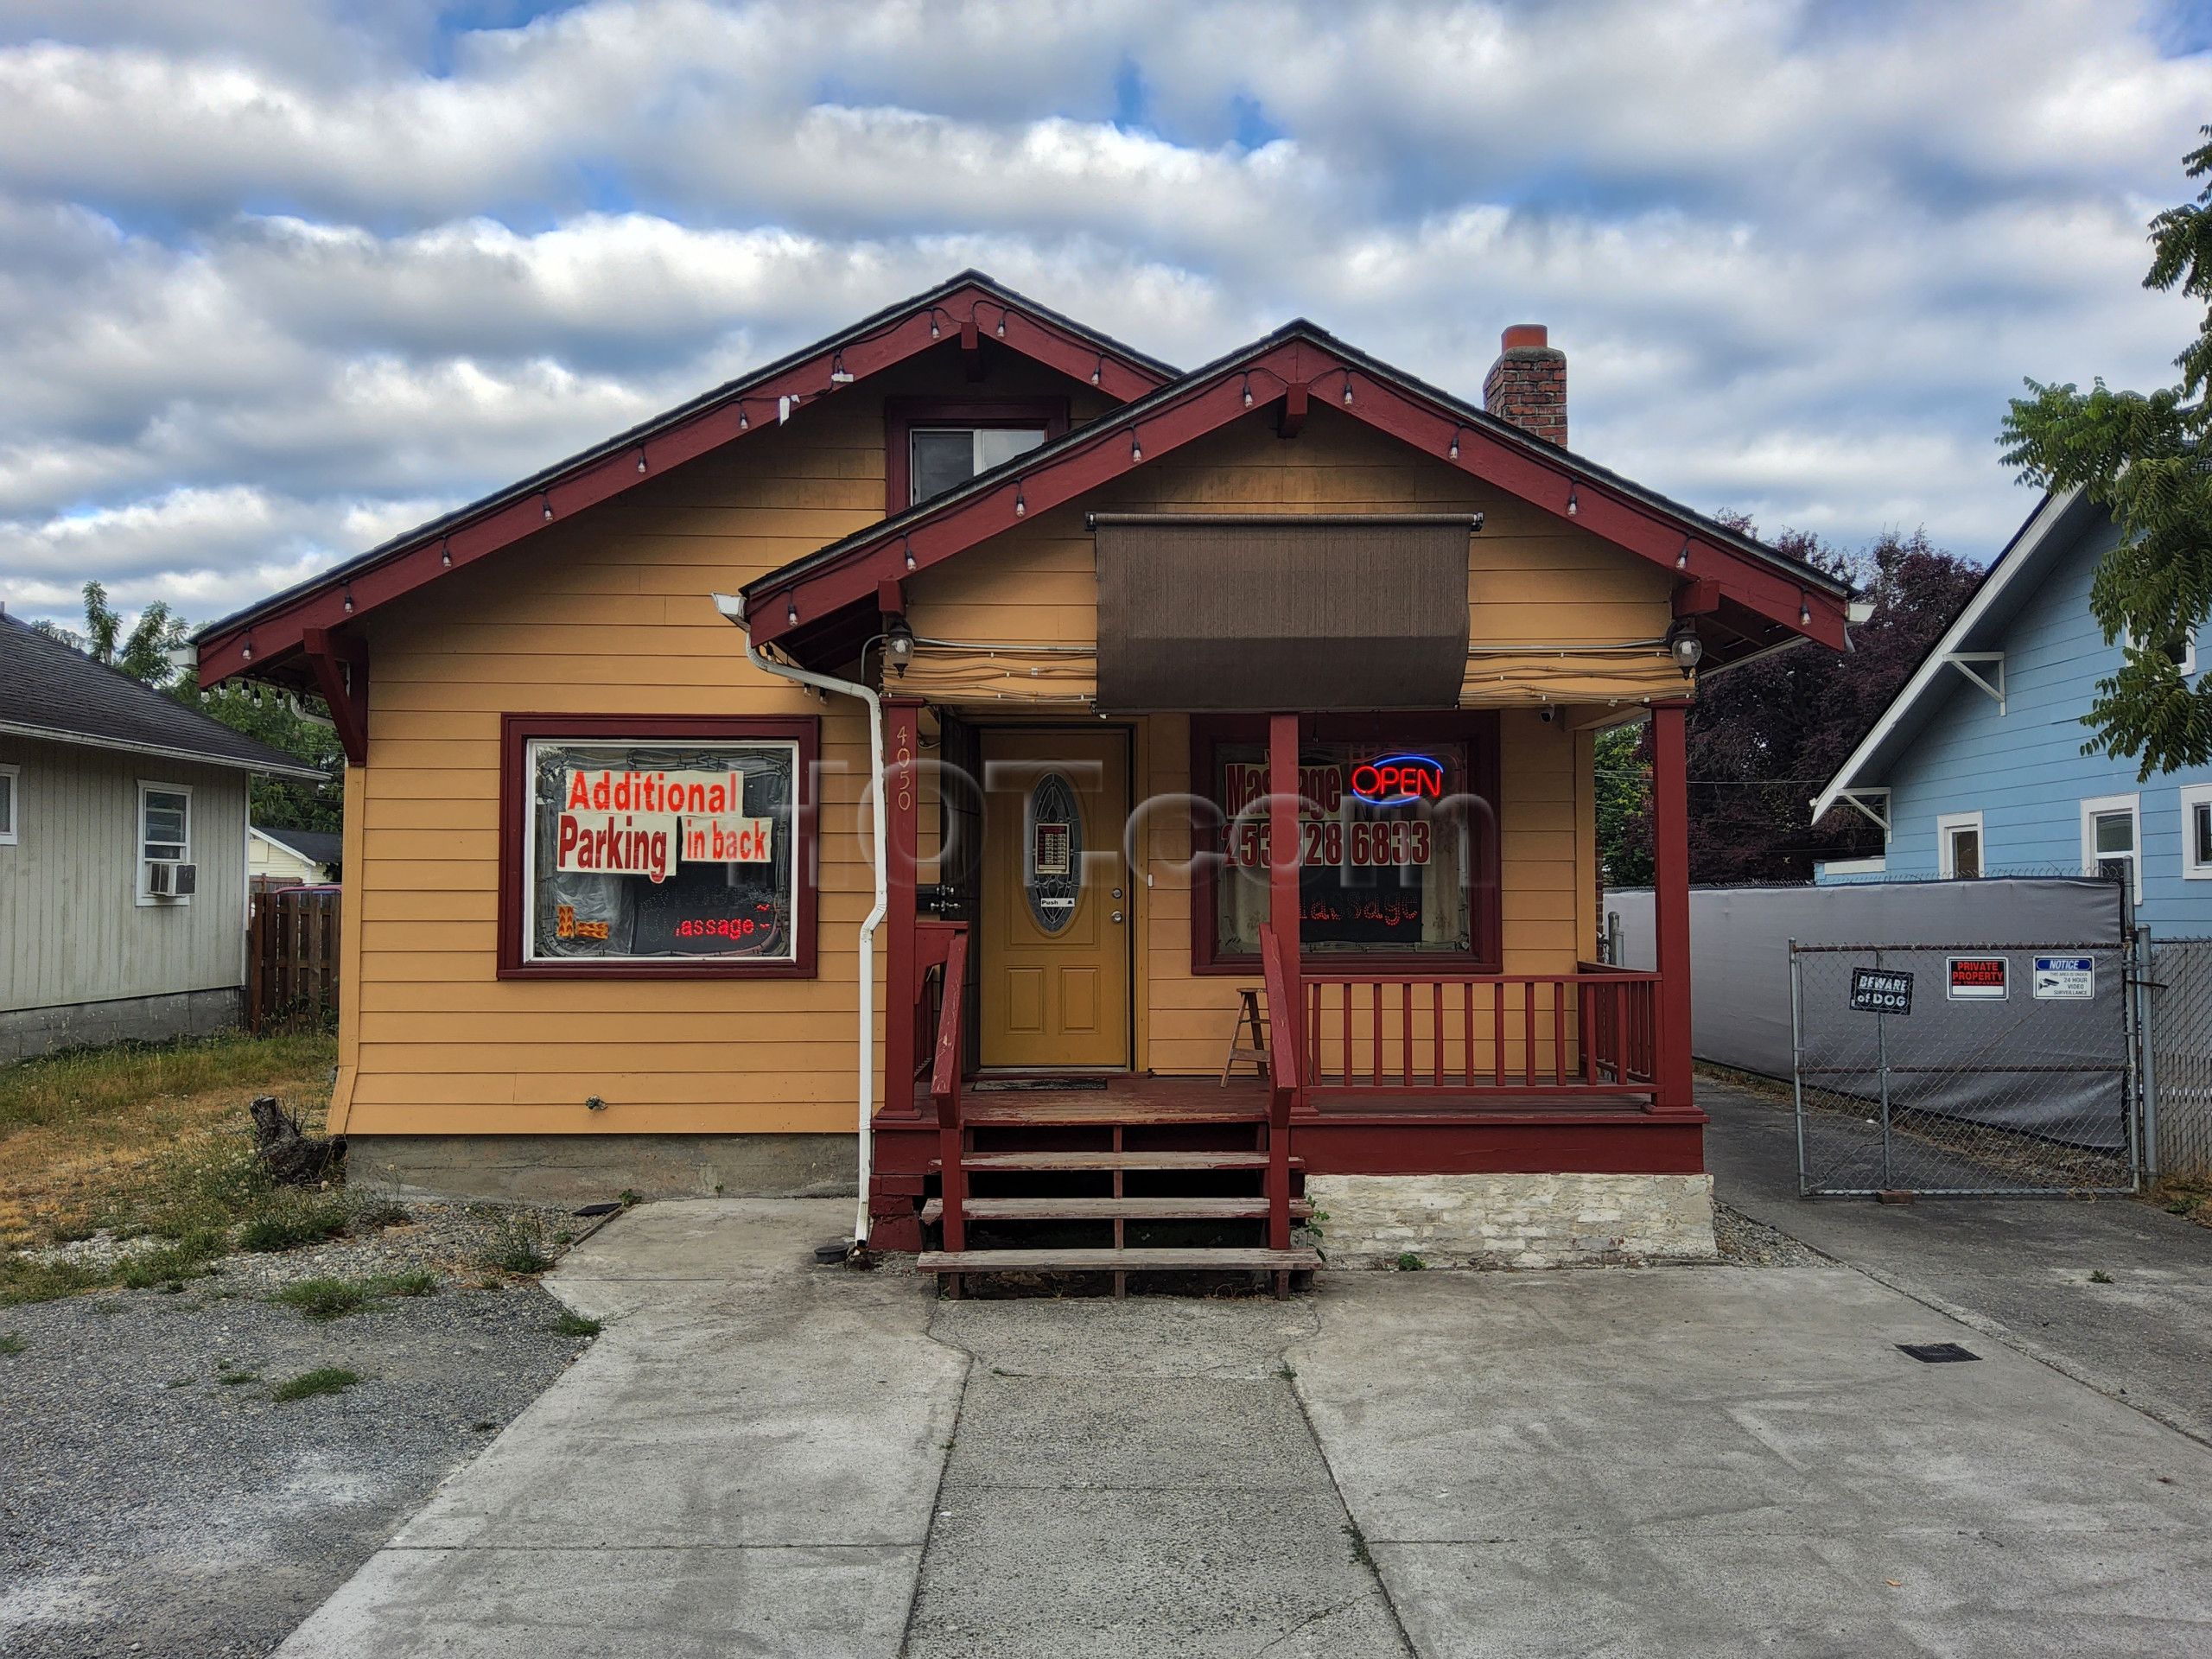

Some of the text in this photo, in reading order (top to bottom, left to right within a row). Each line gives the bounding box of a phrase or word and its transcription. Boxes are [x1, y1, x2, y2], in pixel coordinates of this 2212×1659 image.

[896, 726, 911, 810] 4050
[1351, 766, 1441, 797] OPEN
[568, 770, 737, 813] Additional
[1227, 765, 1341, 820] Masage
[559, 815, 767, 883] Parking in back
[1299, 823, 1343, 865] 28
[1351, 822, 1430, 864] 6833
[675, 918, 755, 941] assage
[1952, 971, 2003, 981] PROPERTY
[1957, 962, 1999, 971] PRIVATE
[2049, 960, 2080, 969] NOTICE
[1859, 976, 1908, 992] BEWARE
[1857, 993, 1906, 1007] of DOG
